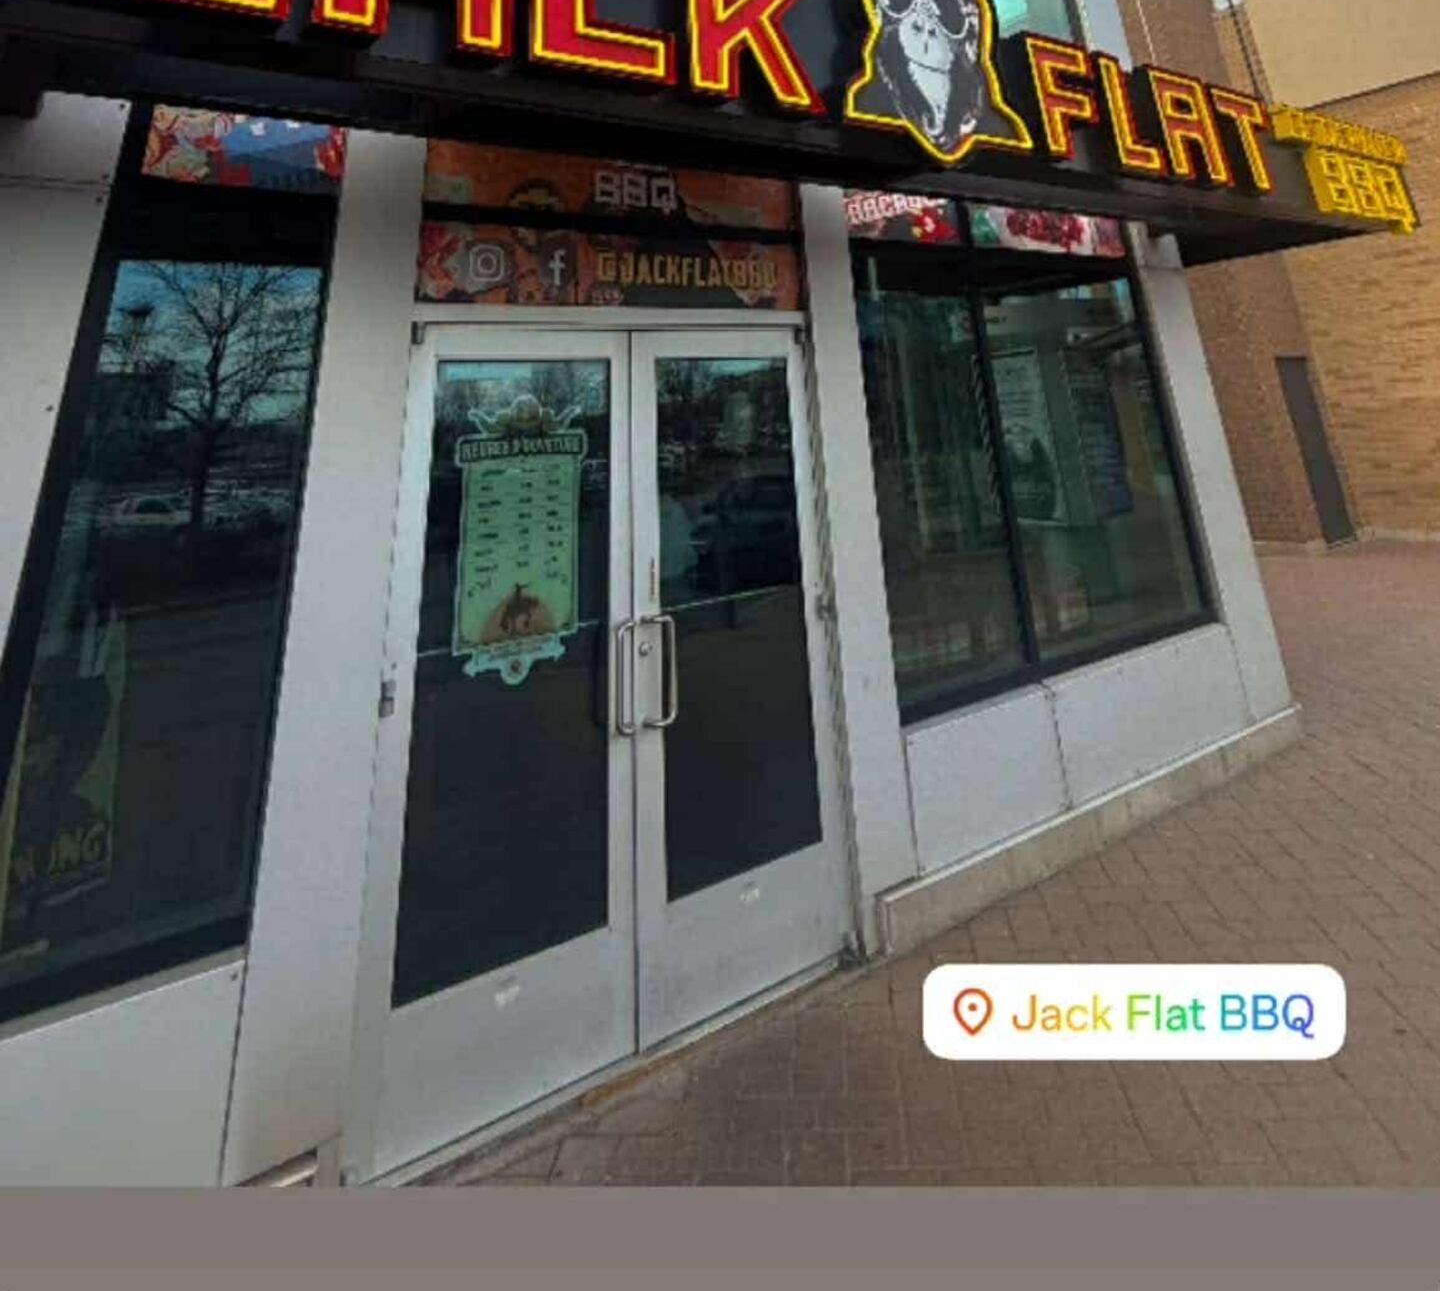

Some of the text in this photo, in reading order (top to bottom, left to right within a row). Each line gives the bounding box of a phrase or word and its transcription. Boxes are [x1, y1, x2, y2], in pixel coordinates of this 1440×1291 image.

[1022, 32, 1273, 192] FLAT
[593, 170, 679, 214] BBQ
[1308, 146, 1416, 234] BBQ
